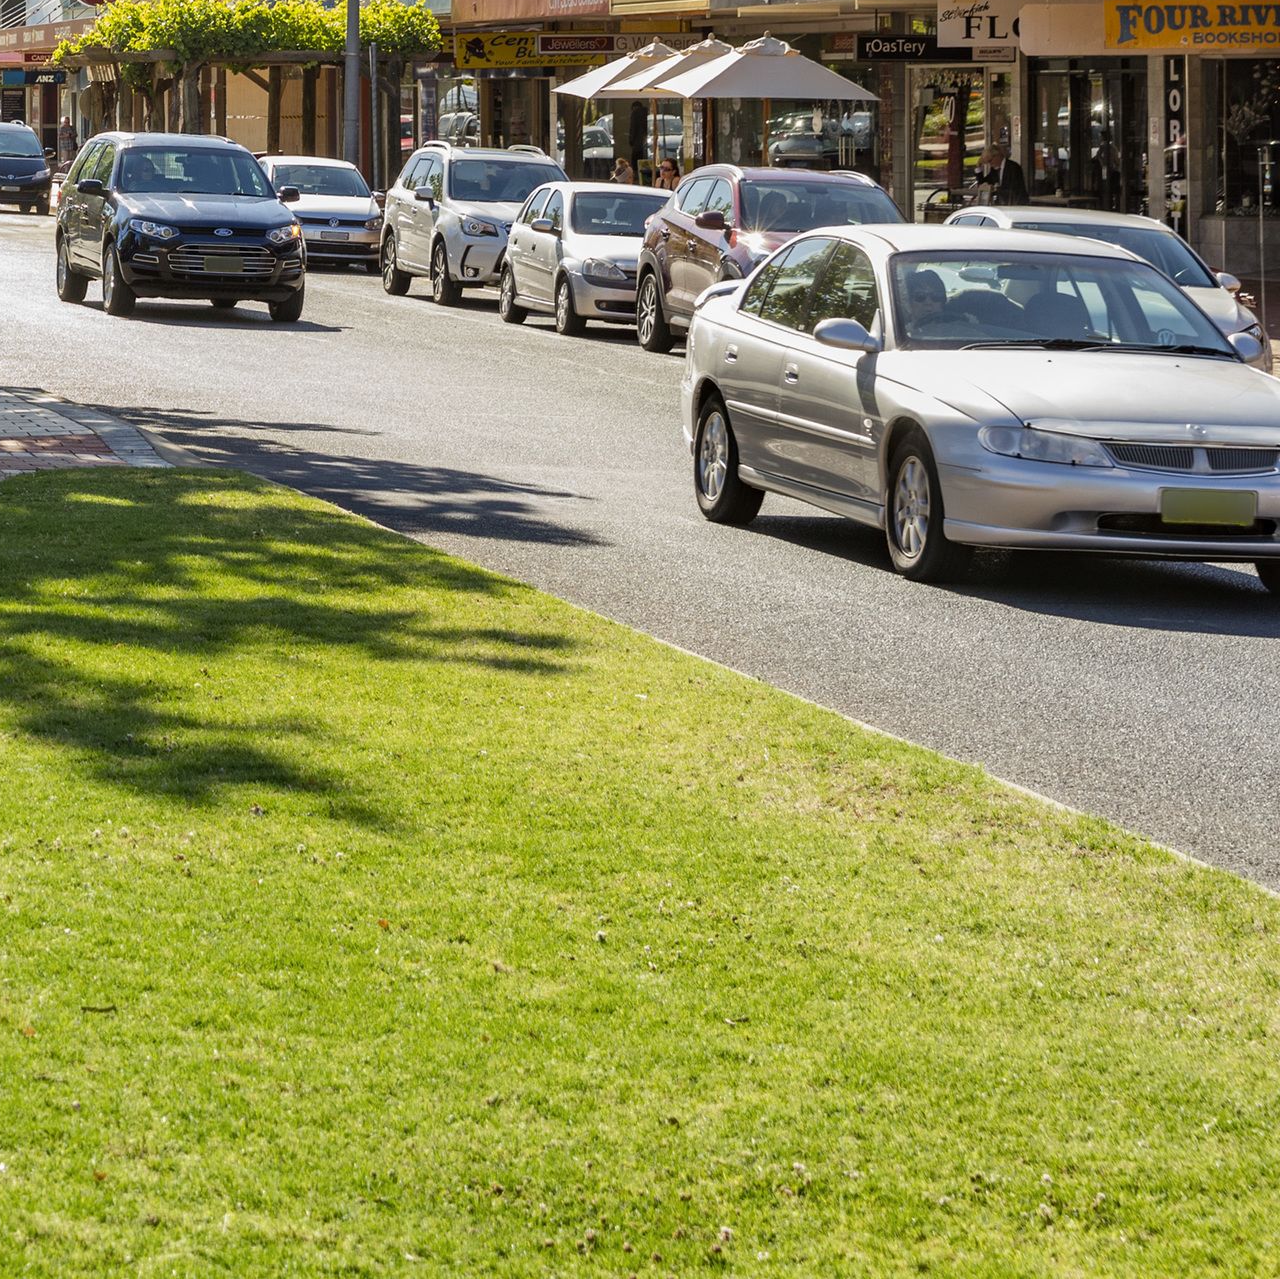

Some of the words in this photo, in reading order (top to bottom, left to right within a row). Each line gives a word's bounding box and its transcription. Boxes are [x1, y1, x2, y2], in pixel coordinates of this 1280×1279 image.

[1116, 5, 1212, 44] FOUR
[548, 39, 596, 50] Jewellers
[1193, 32, 1280, 44] BOOKSHO
[866, 39, 925, 56] rOasTery
